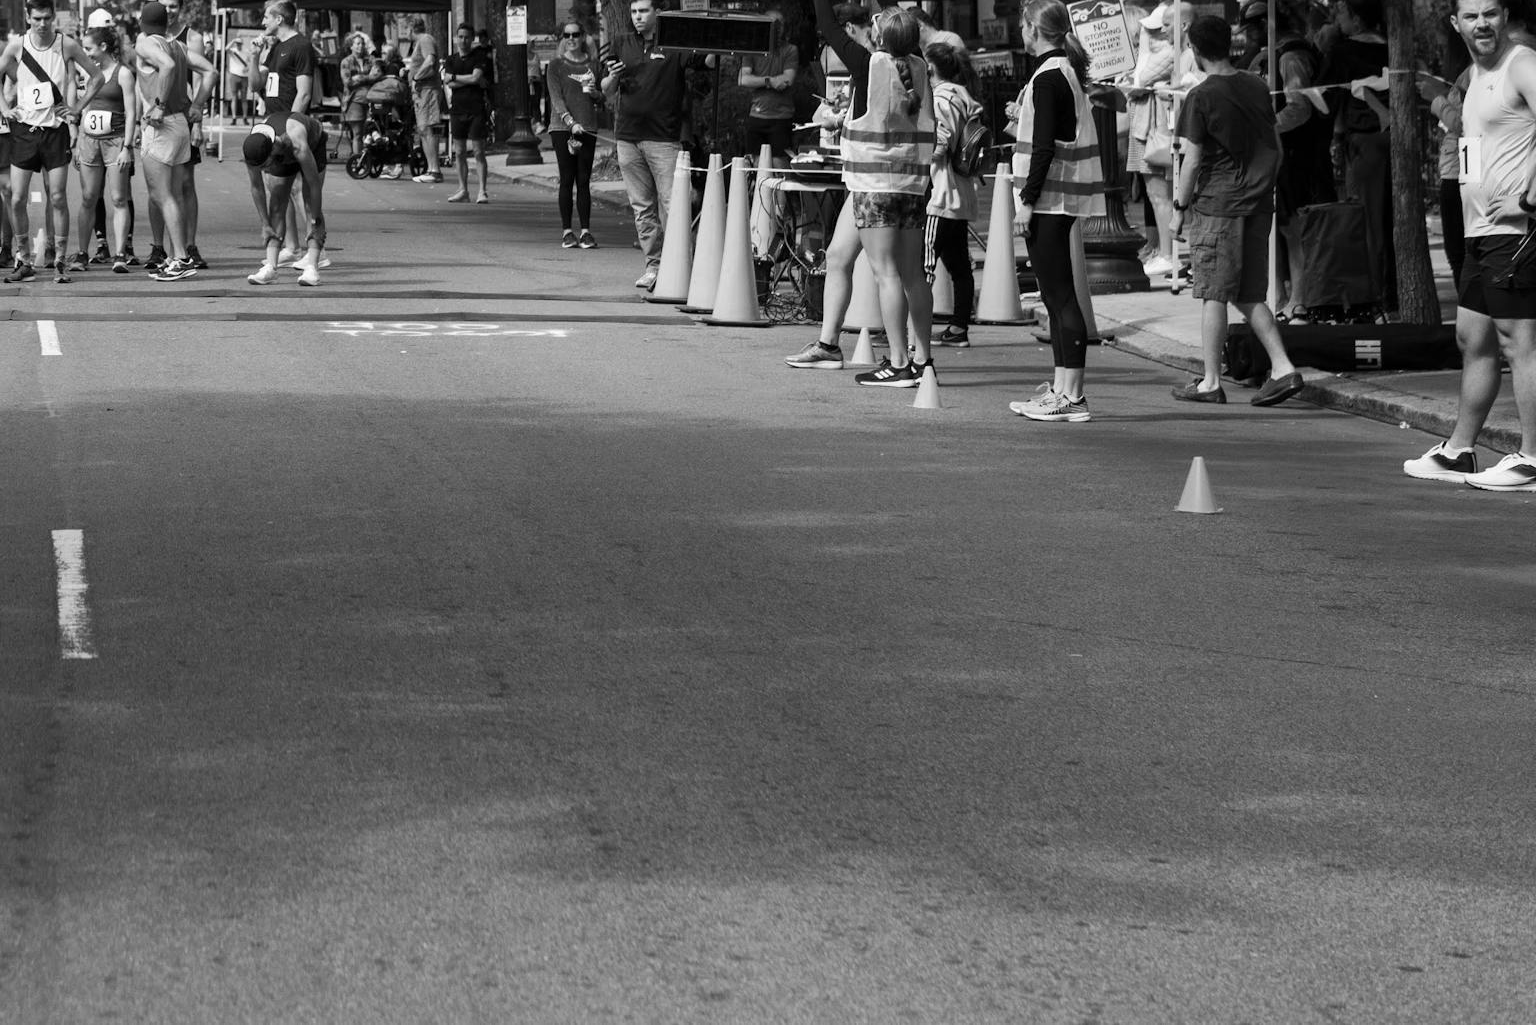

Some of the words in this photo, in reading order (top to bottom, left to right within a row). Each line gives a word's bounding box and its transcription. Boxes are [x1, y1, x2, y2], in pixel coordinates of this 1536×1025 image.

[1094, 22, 1108, 31] NO
[1085, 27, 1121, 41] STOPPING
[1095, 55, 1125, 69] SUNDAY
[33, 89, 42, 104] 2
[90, 115, 104, 130] 31
